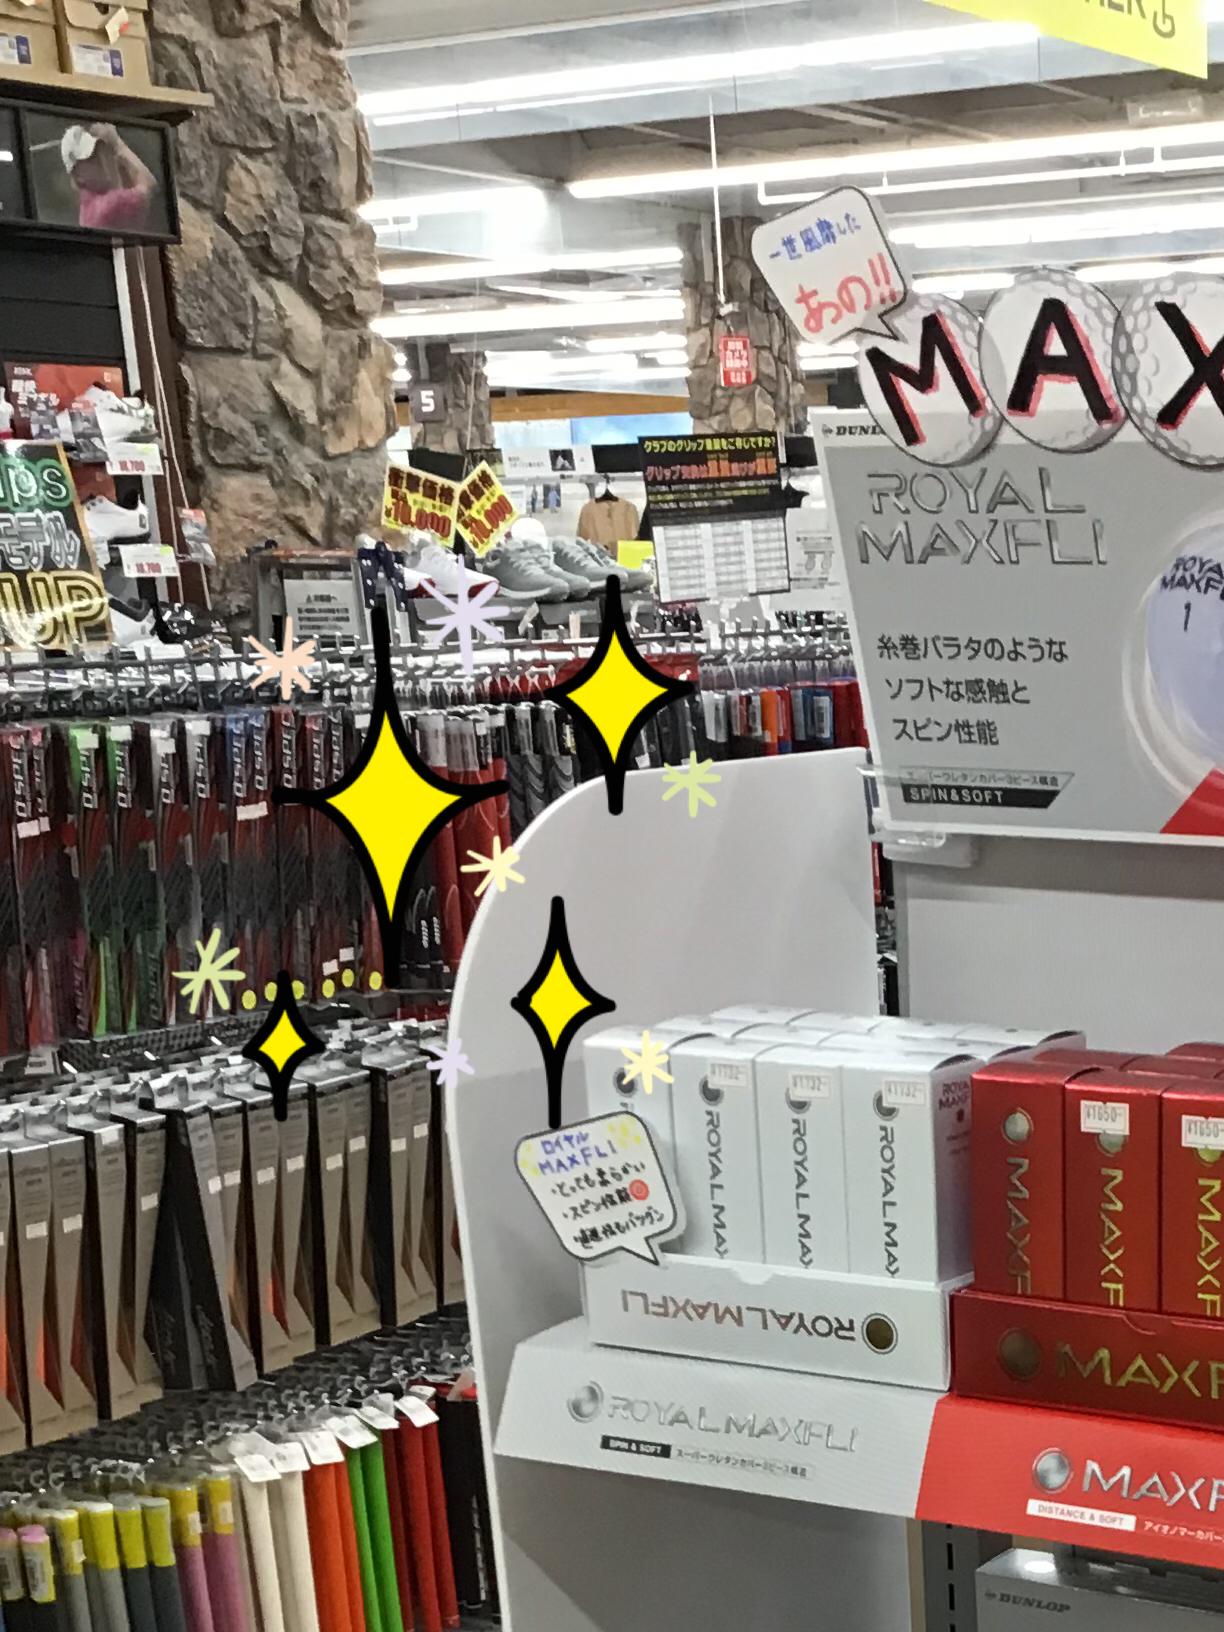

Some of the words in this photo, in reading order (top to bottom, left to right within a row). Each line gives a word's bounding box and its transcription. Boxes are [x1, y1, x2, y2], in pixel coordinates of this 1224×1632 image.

[420, 390, 435, 412] 5
[867, 467, 1087, 515] ROYAL
[856, 518, 1107, 565] MAXFLI
[877, 633, 1069, 663] 糸巻バラタのような
[884, 678, 1031, 704] ソフトな感触と
[893, 719, 1000, 746] スピン性能
[538, 1140, 617, 1175] MAXFLI
[997, 1591, 1070, 1614] DUNLOP
